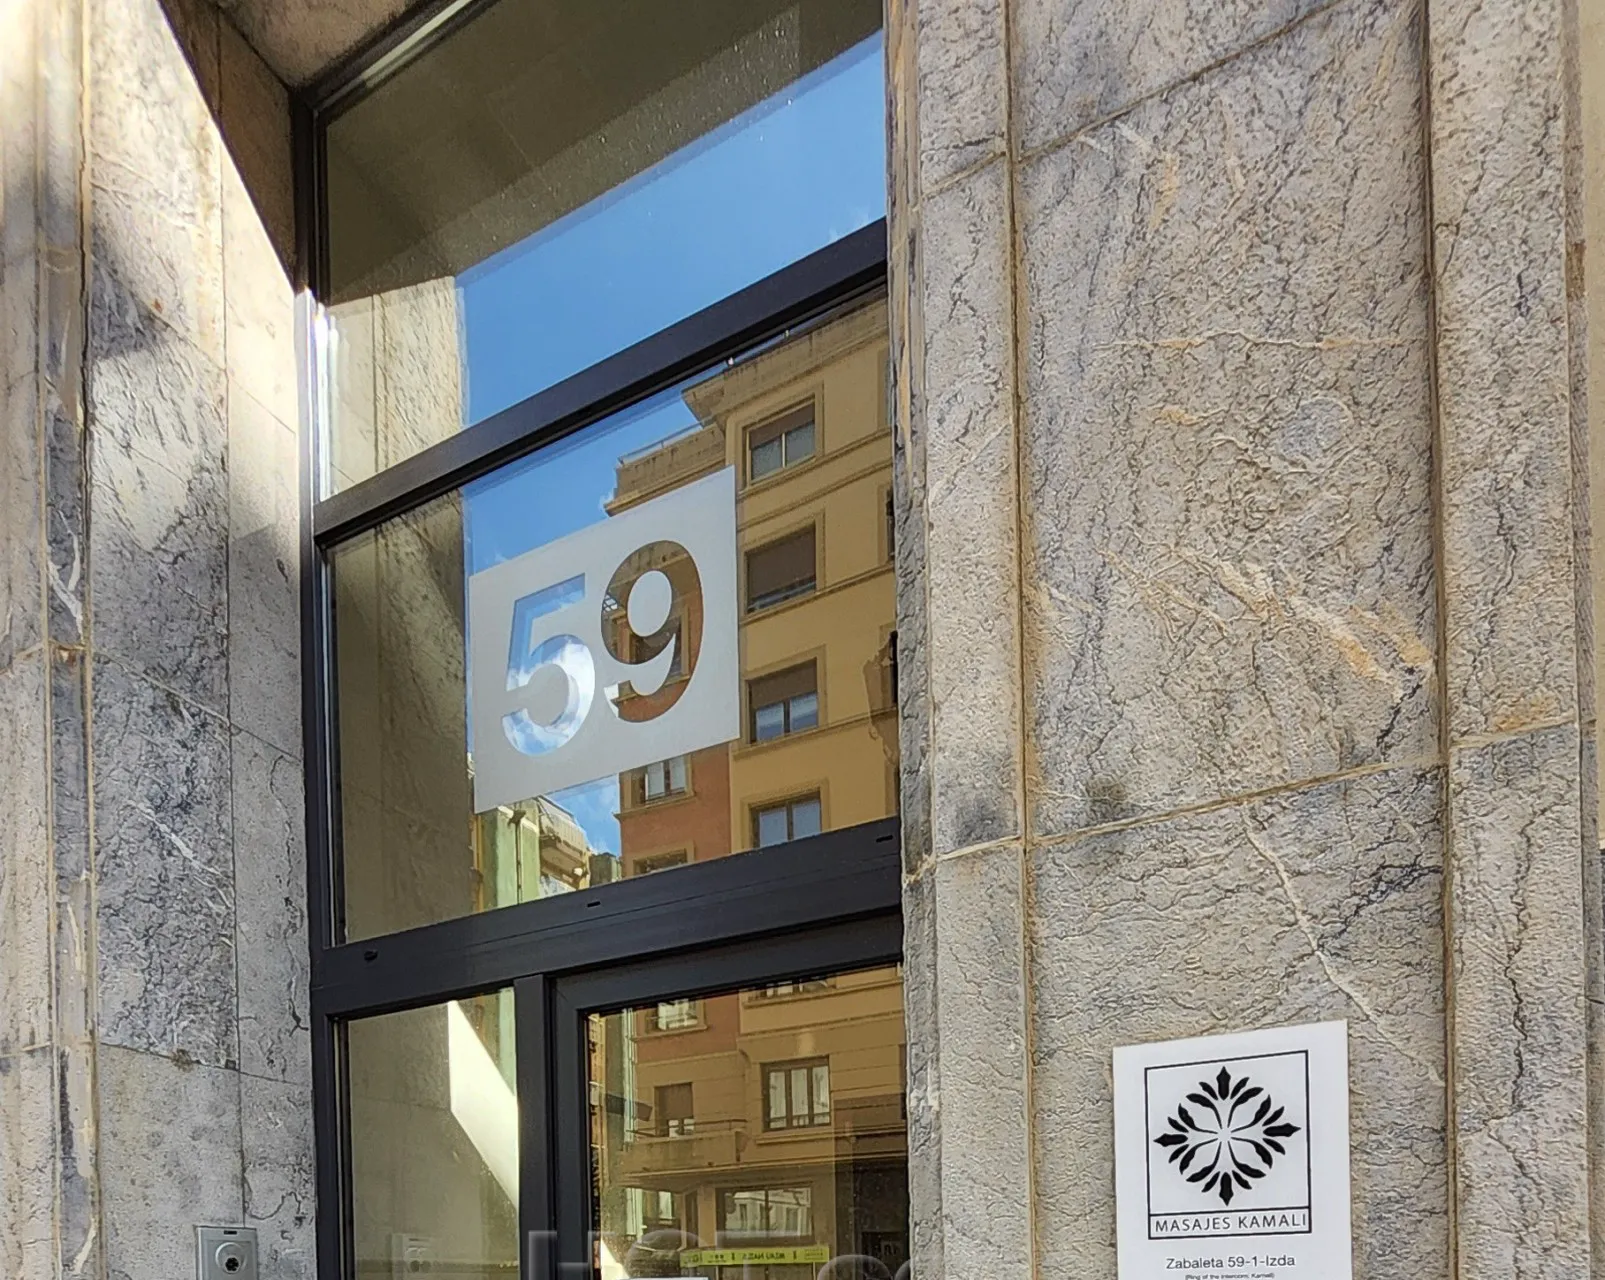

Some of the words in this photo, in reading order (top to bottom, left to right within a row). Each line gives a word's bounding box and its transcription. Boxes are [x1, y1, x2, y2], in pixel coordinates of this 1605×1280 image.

[500, 539, 705, 757] 59
[1155, 1217, 1231, 1233] MASAJES
[1238, 1213, 1307, 1229] KAMALI
[1166, 1257, 1224, 1270] Zabaleta
[1227, 1255, 1296, 1268] 59-1-Izda
